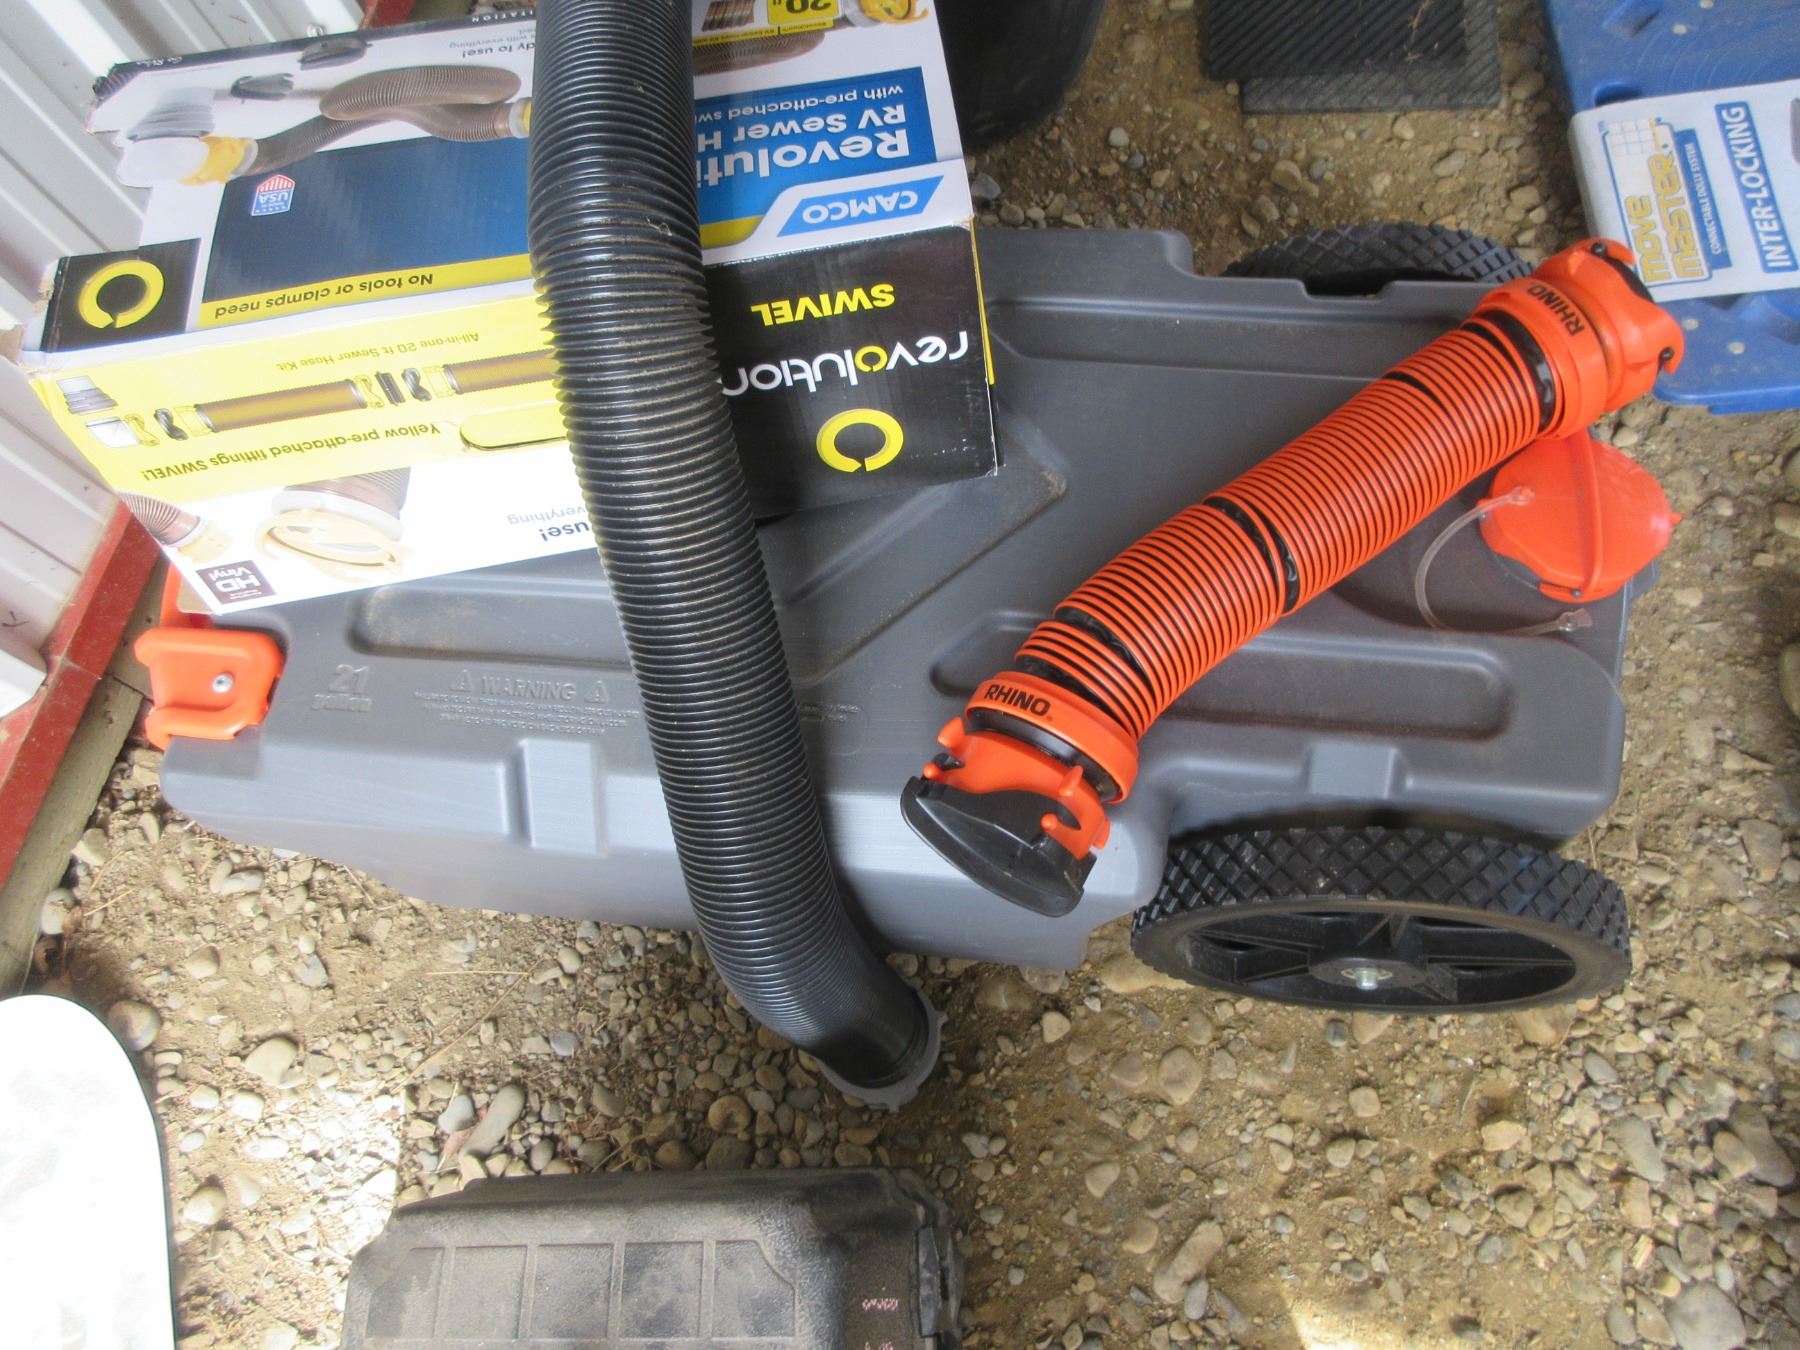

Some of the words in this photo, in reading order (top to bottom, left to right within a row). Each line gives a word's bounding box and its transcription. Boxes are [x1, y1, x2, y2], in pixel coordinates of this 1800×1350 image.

[471, 10, 533, 23] ITATION
[864, 85, 903, 100] with
[728, 89, 857, 120] pre-attached
[694, 111, 722, 126] swi
[858, 104, 906, 129] RV
[733, 113, 847, 143] Sewer
[696, 129, 910, 188] Revoluti
[1684, 142, 1701, 172] SYSTEM
[1693, 172, 1709, 198] DOLLY
[1720, 106, 1792, 268] INTER-LOCKING
[259, 192, 288, 204] USA
[802, 190, 918, 224] CAMCO
[1698, 199, 1722, 255] CONNECTABLE
[335, 284, 354, 296] or
[359, 277, 402, 293] tools
[408, 274, 433, 287] No
[265, 287, 331, 309] clamps
[751, 283, 895, 326] SWIVEL
[215, 300, 260, 319] need
[1527, 284, 1585, 336] RHINO
[397, 342, 417, 353] 20
[419, 332, 479, 348] All-in-one
[338, 347, 380, 360] Sewer
[382, 345, 393, 355] ft
[275, 360, 297, 371] Kit
[300, 355, 333, 367] Hose
[717, 330, 968, 396] revolution
[384, 423, 440, 440] Yellow
[269, 427, 380, 458] pre-attached
[208, 449, 267, 467] fittings
[140, 459, 208, 481] SWIVEL!
[506, 505, 585, 525] verything
[539, 522, 590, 541] use!
[207, 566, 252, 581] Vinyl
[215, 574, 261, 592] HD
[328, 664, 370, 695] 21
[480, 672, 578, 702] WARNING
[983, 684, 1051, 717] RHINO
